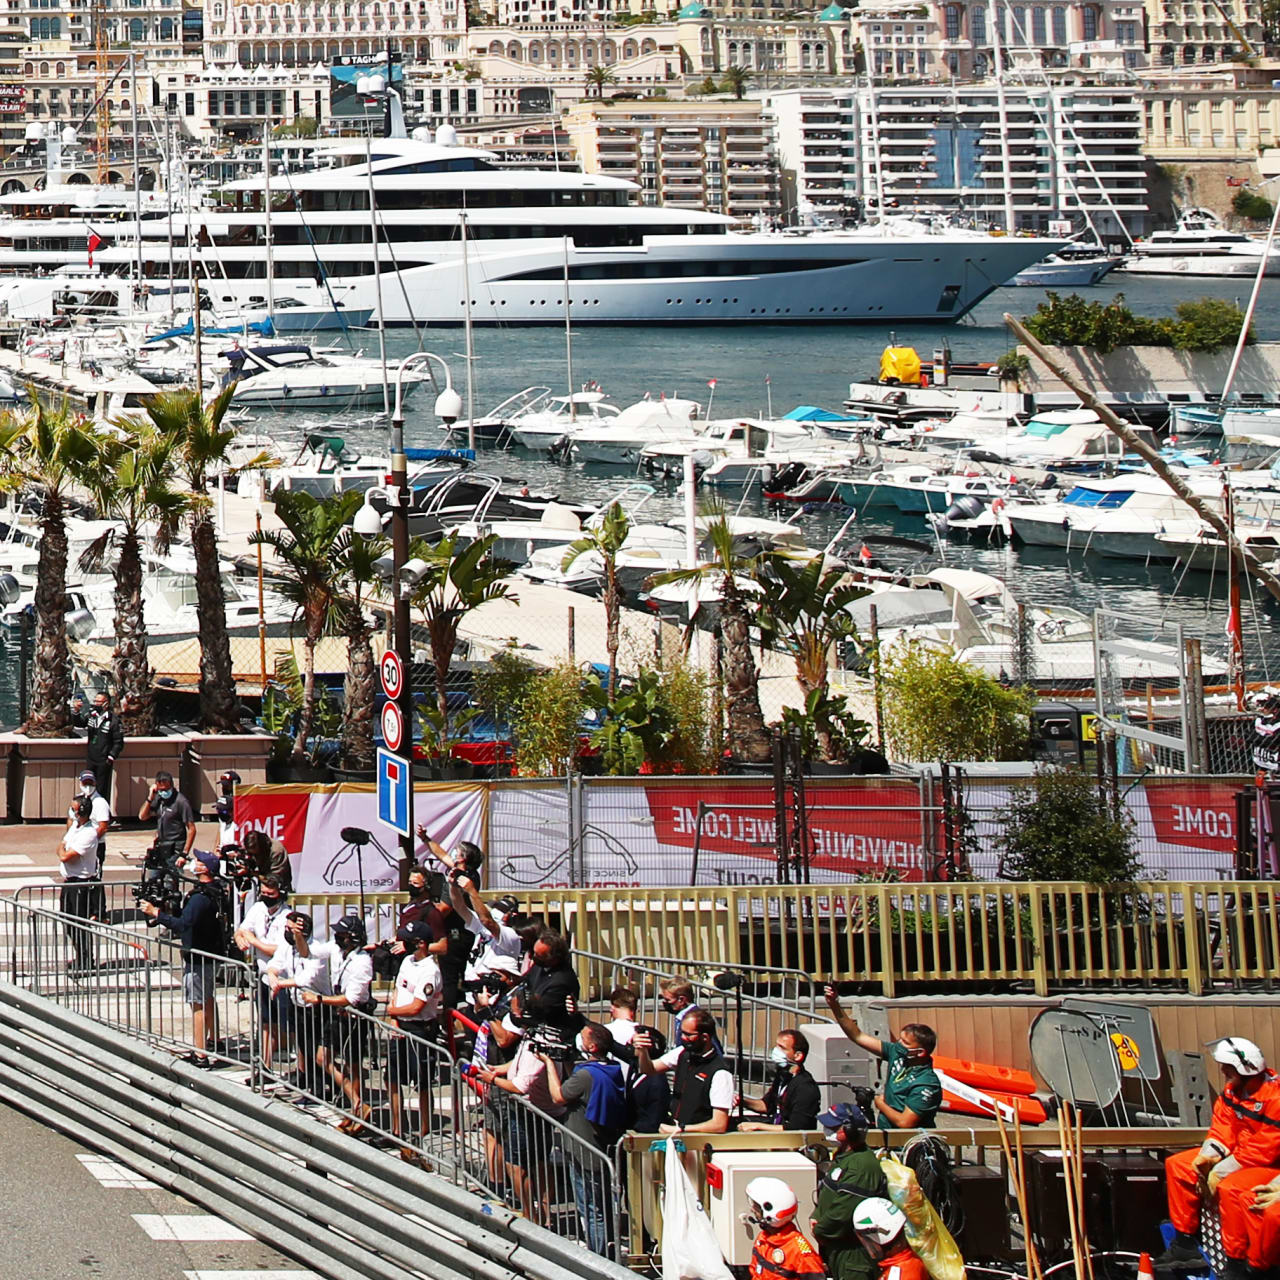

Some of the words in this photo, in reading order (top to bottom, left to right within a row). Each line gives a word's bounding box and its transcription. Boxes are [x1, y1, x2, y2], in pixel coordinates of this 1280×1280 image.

[385, 663, 397, 686] 30
[336, 879, 368, 887] SINCE
[369, 878, 394, 887] 1929
